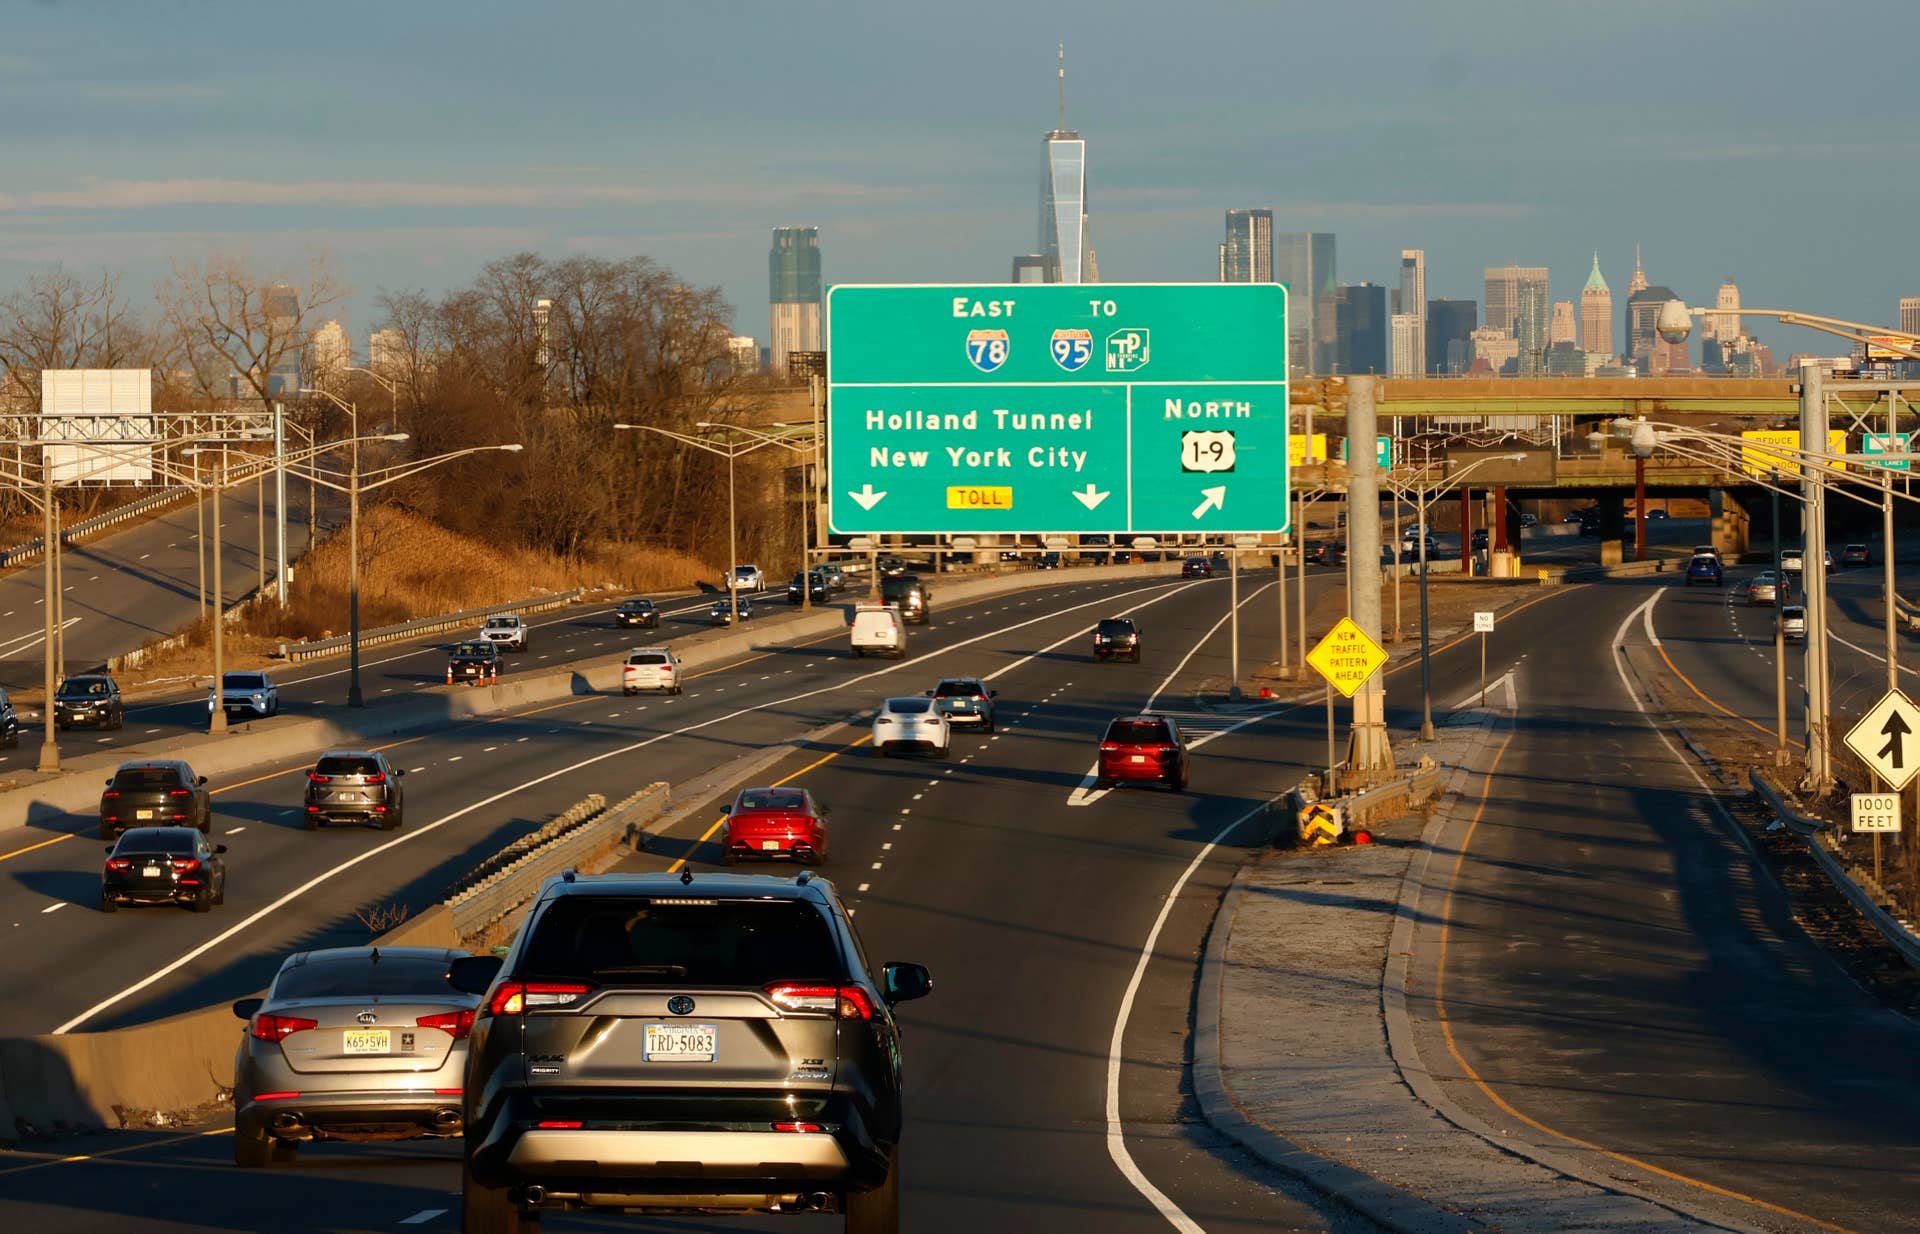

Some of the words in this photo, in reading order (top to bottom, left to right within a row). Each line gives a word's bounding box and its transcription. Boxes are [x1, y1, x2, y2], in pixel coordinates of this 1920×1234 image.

[970, 340, 1007, 364] 78
[1054, 340, 1091, 364] 95
[865, 409, 978, 431] Holland
[992, 409, 1092, 431] Tunnel
[1193, 441, 1224, 462] 1-9
[870, 447, 929, 468] New
[945, 447, 1012, 468] York
[1027, 446, 1088, 473] City
[958, 490, 1003, 506] TOLL
[1337, 631, 1357, 641] NEW
[1330, 644, 1367, 654] TRAFFIC
[1330, 657, 1368, 668] PATTERN
[1335, 671, 1364, 681] AHEAD
[1858, 798, 1893, 810] 1000
[1858, 815, 1893, 827] FEET
